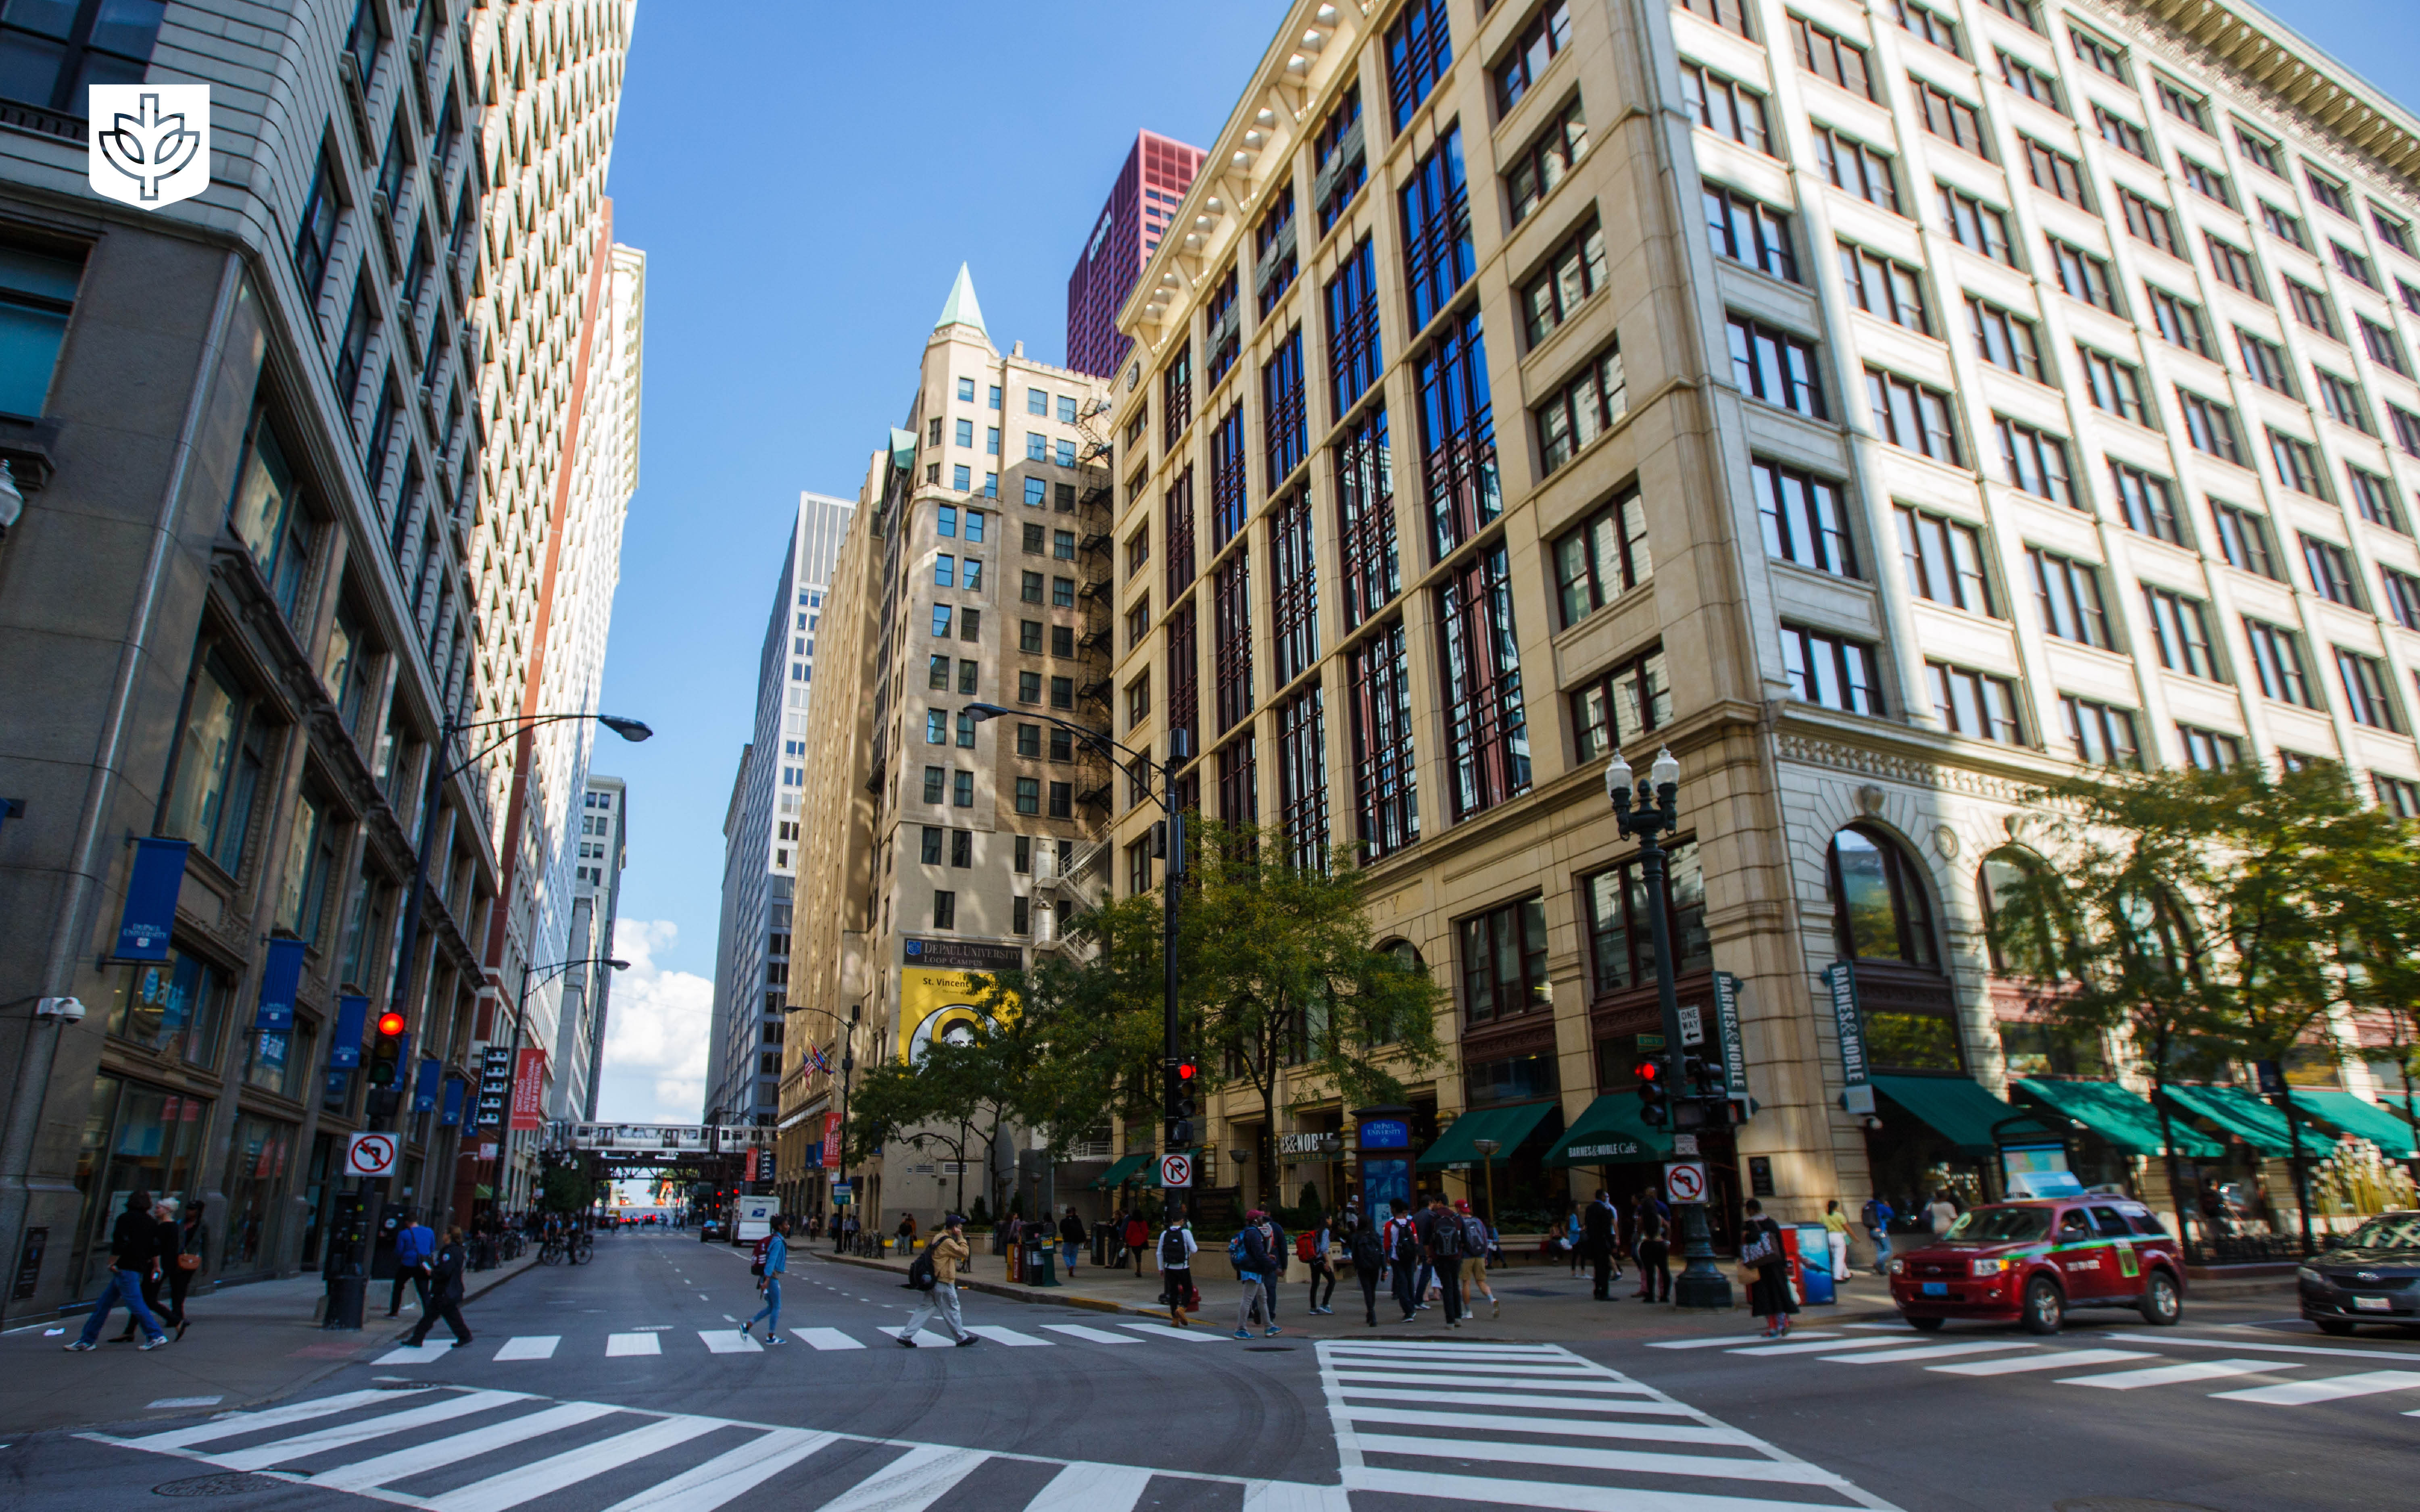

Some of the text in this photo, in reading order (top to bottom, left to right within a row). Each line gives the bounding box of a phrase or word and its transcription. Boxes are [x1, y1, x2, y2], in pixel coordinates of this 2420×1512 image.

[963, 946, 1020, 960] UNIVERSITY
[937, 979, 969, 987] Vincent
[1681, 1010, 1698, 1020] ONE
[1682, 1020, 1699, 1031] WAY
[524, 1057, 535, 1112] INTERNATIONAL
[533, 1061, 542, 1094] FESTIVAL
[516, 1078, 525, 1112] CHICAGO
